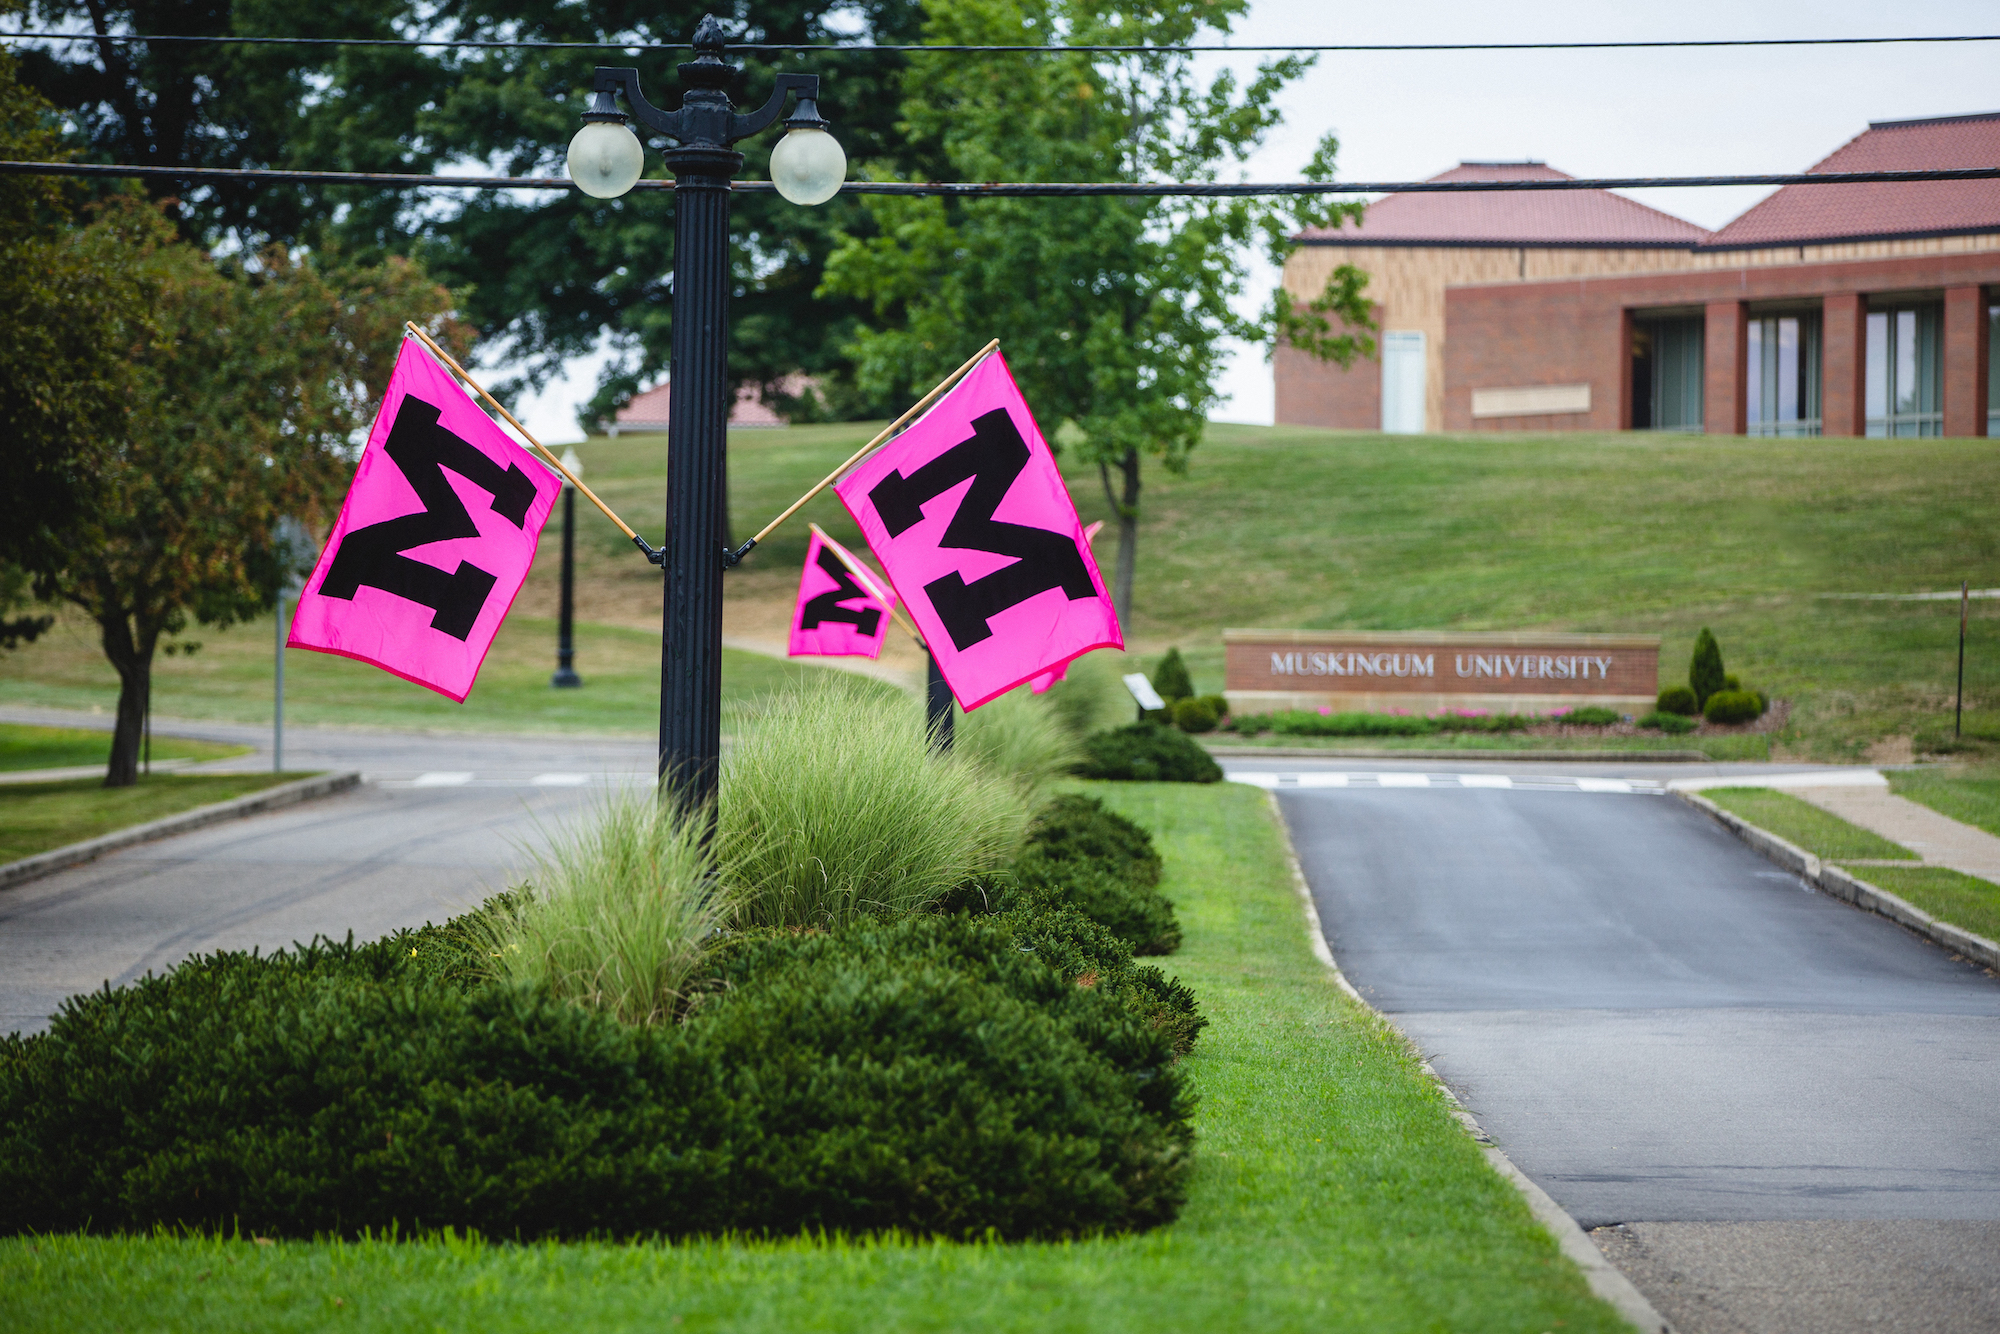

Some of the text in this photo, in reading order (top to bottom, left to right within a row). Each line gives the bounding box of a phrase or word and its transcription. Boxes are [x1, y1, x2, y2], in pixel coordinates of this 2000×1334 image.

[318, 394, 537, 641] M
[867, 408, 1098, 653] M
[1270, 652, 1613, 680] MUSKINGUM UNIVERSITY
